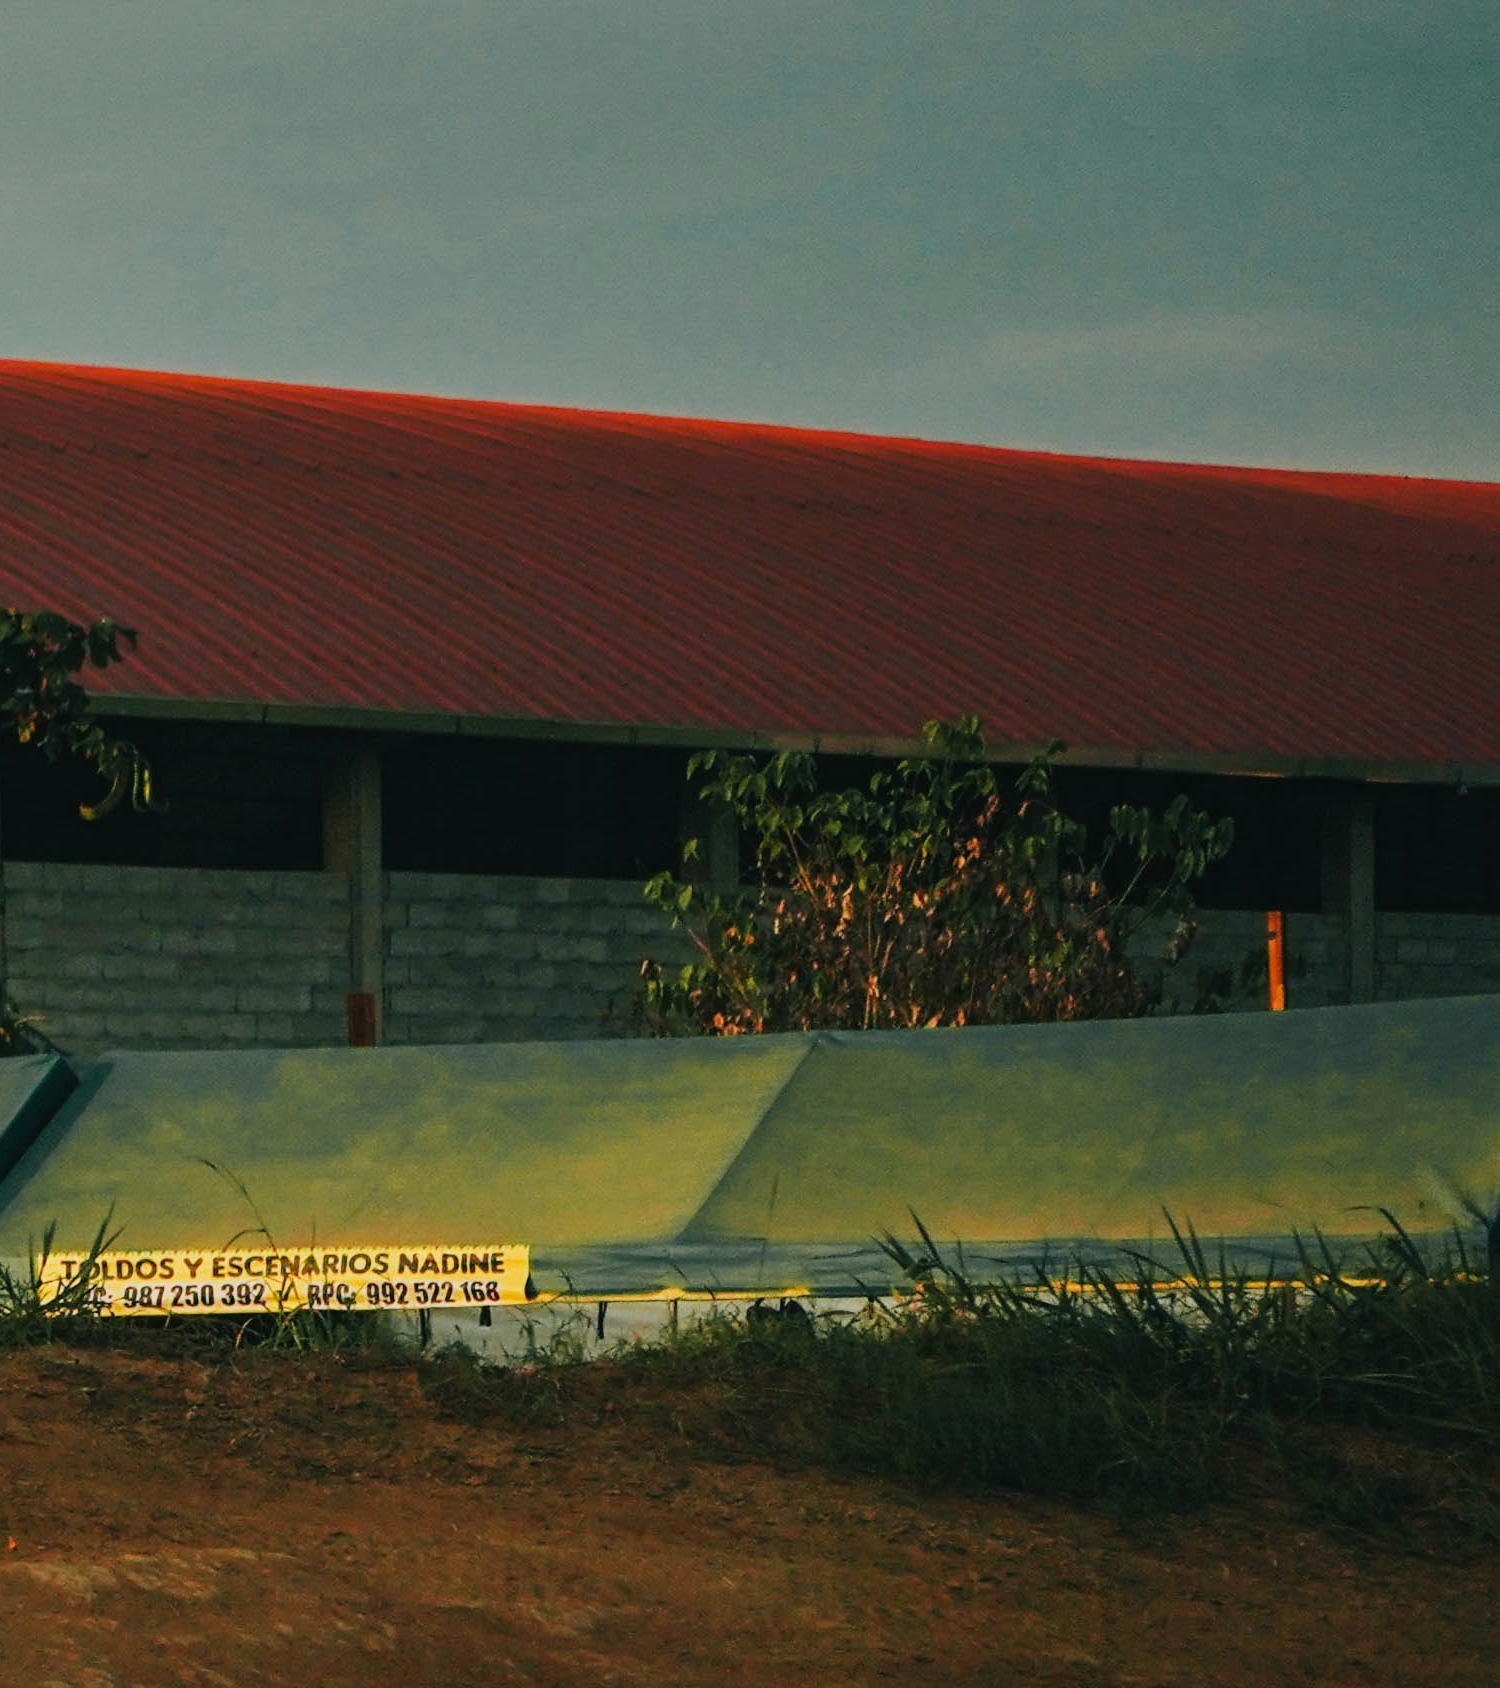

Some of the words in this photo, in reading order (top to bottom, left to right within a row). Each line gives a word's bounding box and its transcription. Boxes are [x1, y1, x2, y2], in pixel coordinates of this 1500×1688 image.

[183, 1257, 203, 1279] Y
[212, 1252, 389, 1279] ESCENARIOS
[398, 1251, 504, 1275] NADINE
[124, 1285, 165, 1308] 987
[171, 1284, 215, 1307] 250
[221, 1283, 265, 1306] 392
[366, 1282, 409, 1305] 992
[414, 1281, 453, 1304] 522
[460, 1280, 500, 1303] 168
